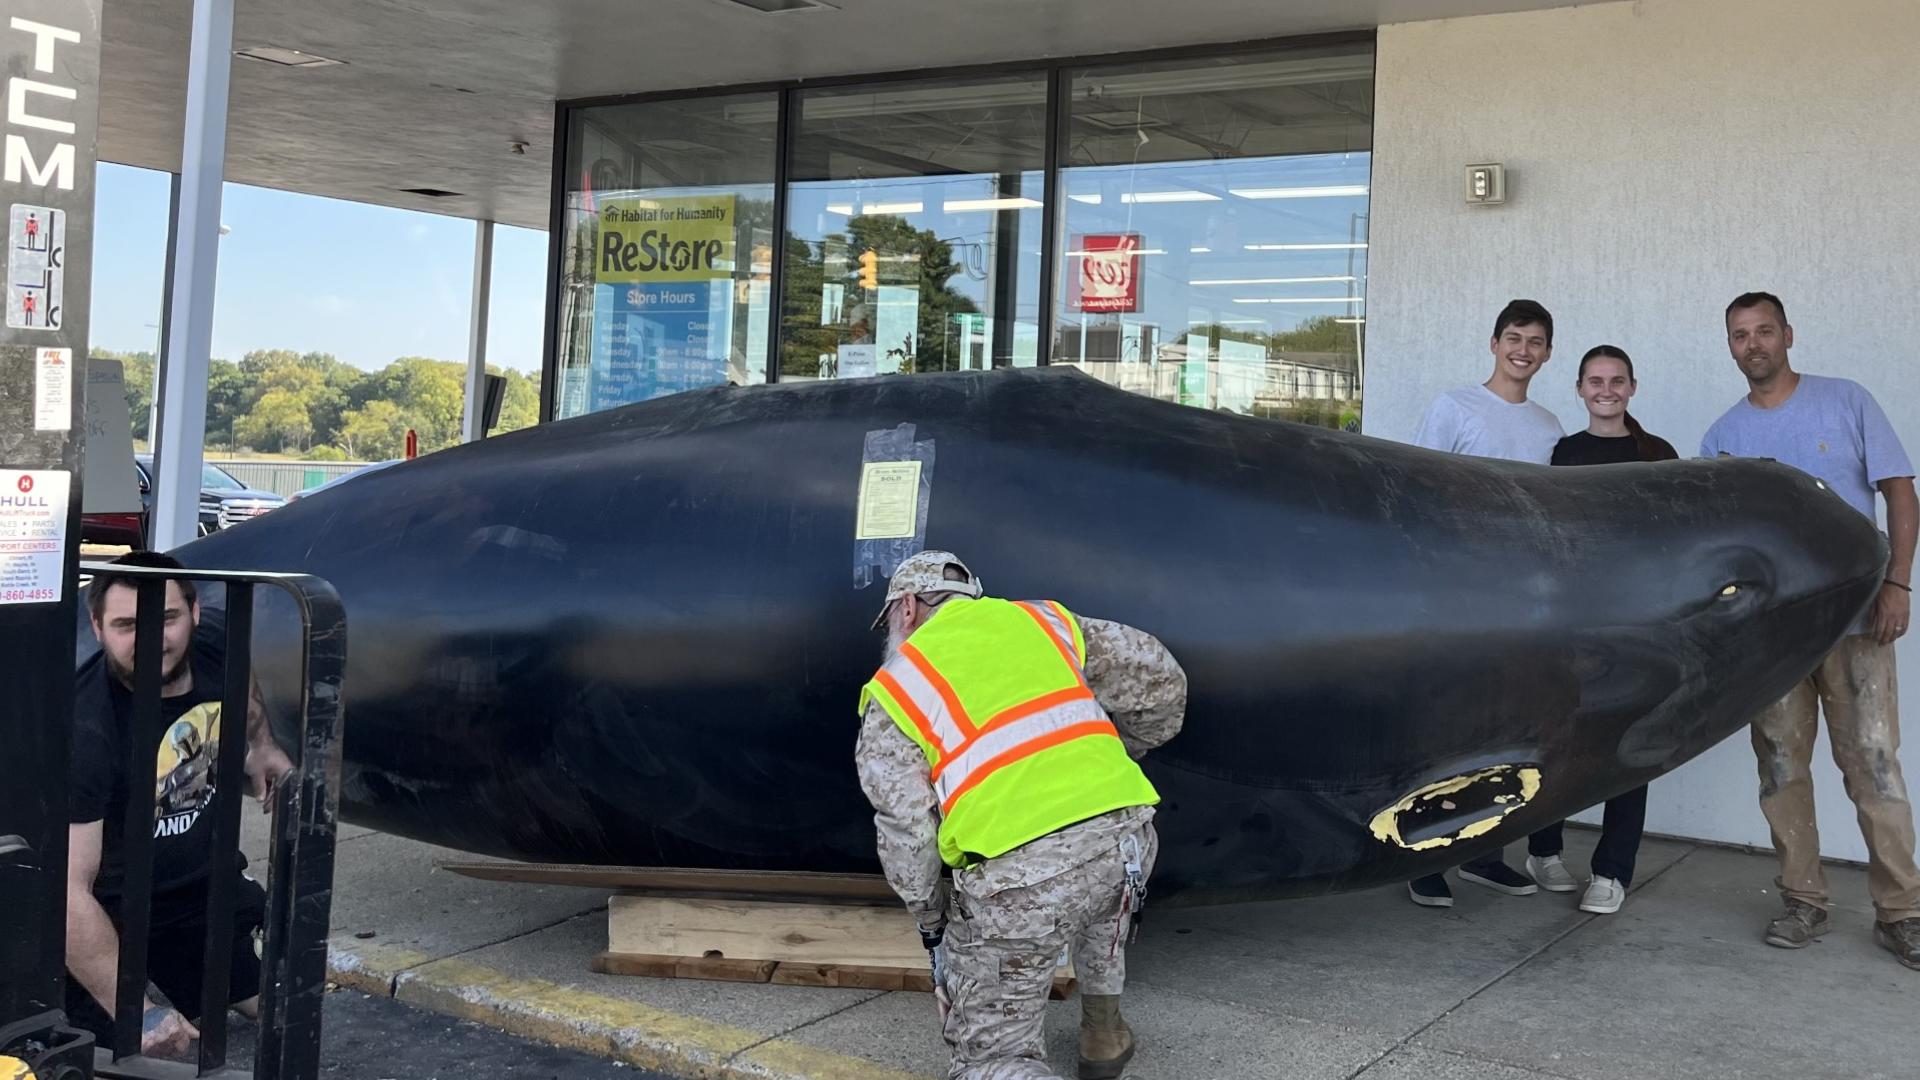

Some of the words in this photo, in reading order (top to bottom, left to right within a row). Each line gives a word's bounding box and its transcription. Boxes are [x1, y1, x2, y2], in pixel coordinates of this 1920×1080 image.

[622, 209, 657, 222] Habitat
[660, 207, 675, 221] for
[677, 206, 726, 221] Humanity
[602, 230, 723, 272] ReStore
[626, 290, 657, 304] Store
[660, 290, 696, 304] Hours
[598, 384, 622, 396] Friday
[0, 496, 49, 507] HULL
[23, 542, 57, 550] CENTERS
